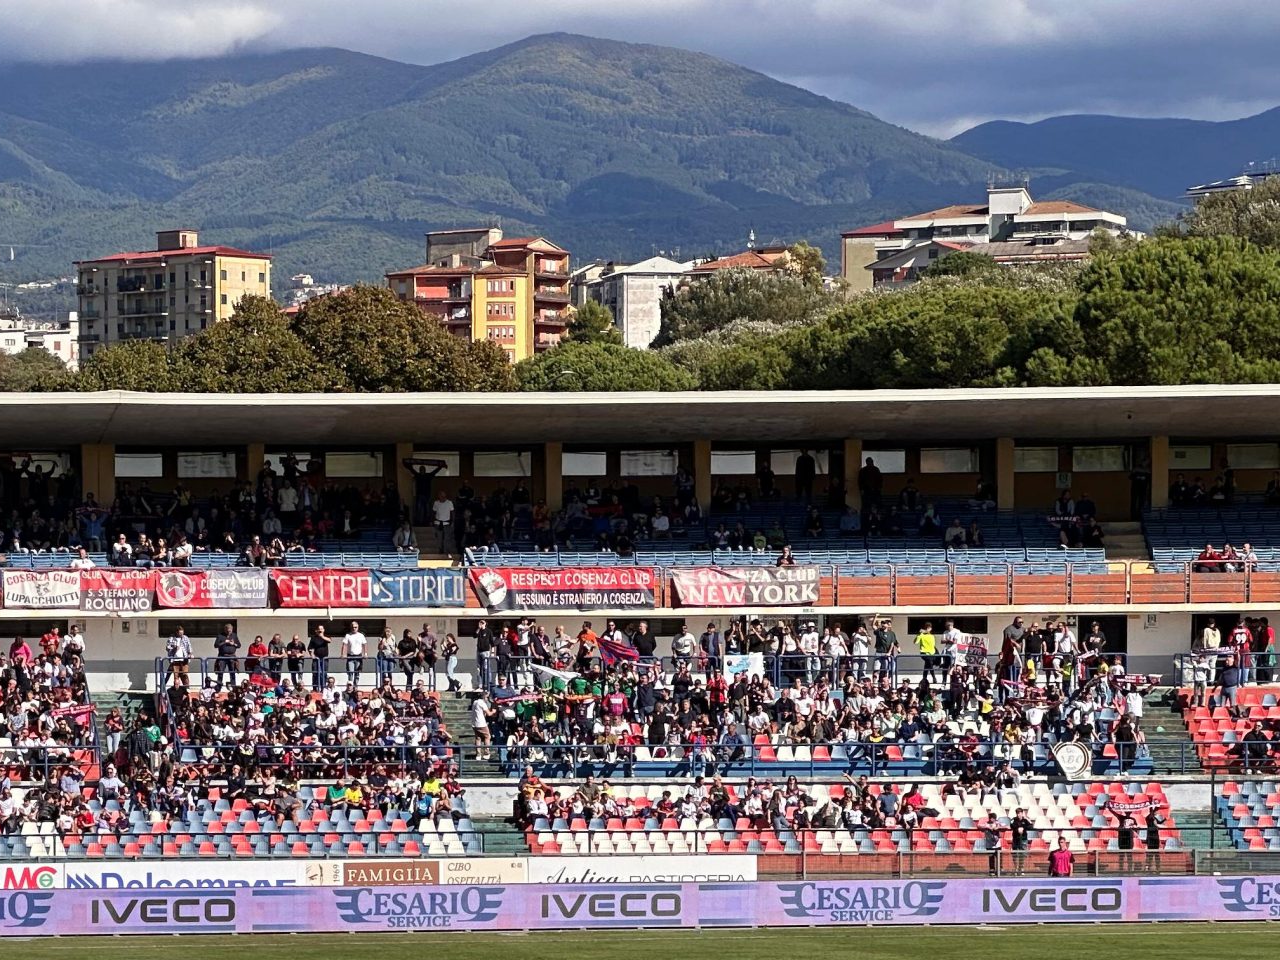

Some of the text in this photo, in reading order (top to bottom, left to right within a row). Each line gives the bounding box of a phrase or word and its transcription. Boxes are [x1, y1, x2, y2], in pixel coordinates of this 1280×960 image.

[6, 573, 78, 586] COSENZA CLUB
[511, 571, 651, 586] RESPECT COSENZA CLUB
[776, 567, 816, 583] CLUB
[241, 578, 265, 590] CLUB
[275, 575, 373, 601] CENTRO
[6, 591, 79, 605] LUPACCHIOTTI
[98, 588, 136, 597] STEFANO
[138, 588, 148, 597] DI
[515, 593, 550, 605] NESSUNO
[558, 593, 602, 605] STRANIERO
[602, 593, 609, 605] A
[609, 593, 646, 605] COSENZA
[688, 582, 818, 604] NEW YORK
[85, 597, 150, 610] ROGLIANO
[448, 862, 471, 872] CIBO
[347, 867, 433, 882] FAMIGLIA
[541, 893, 682, 918] IVECO
[982, 888, 1121, 913] IVECO
[91, 898, 236, 924] IVECO
[830, 910, 894, 922] SERVICE
[387, 916, 452, 928] SERVICE
